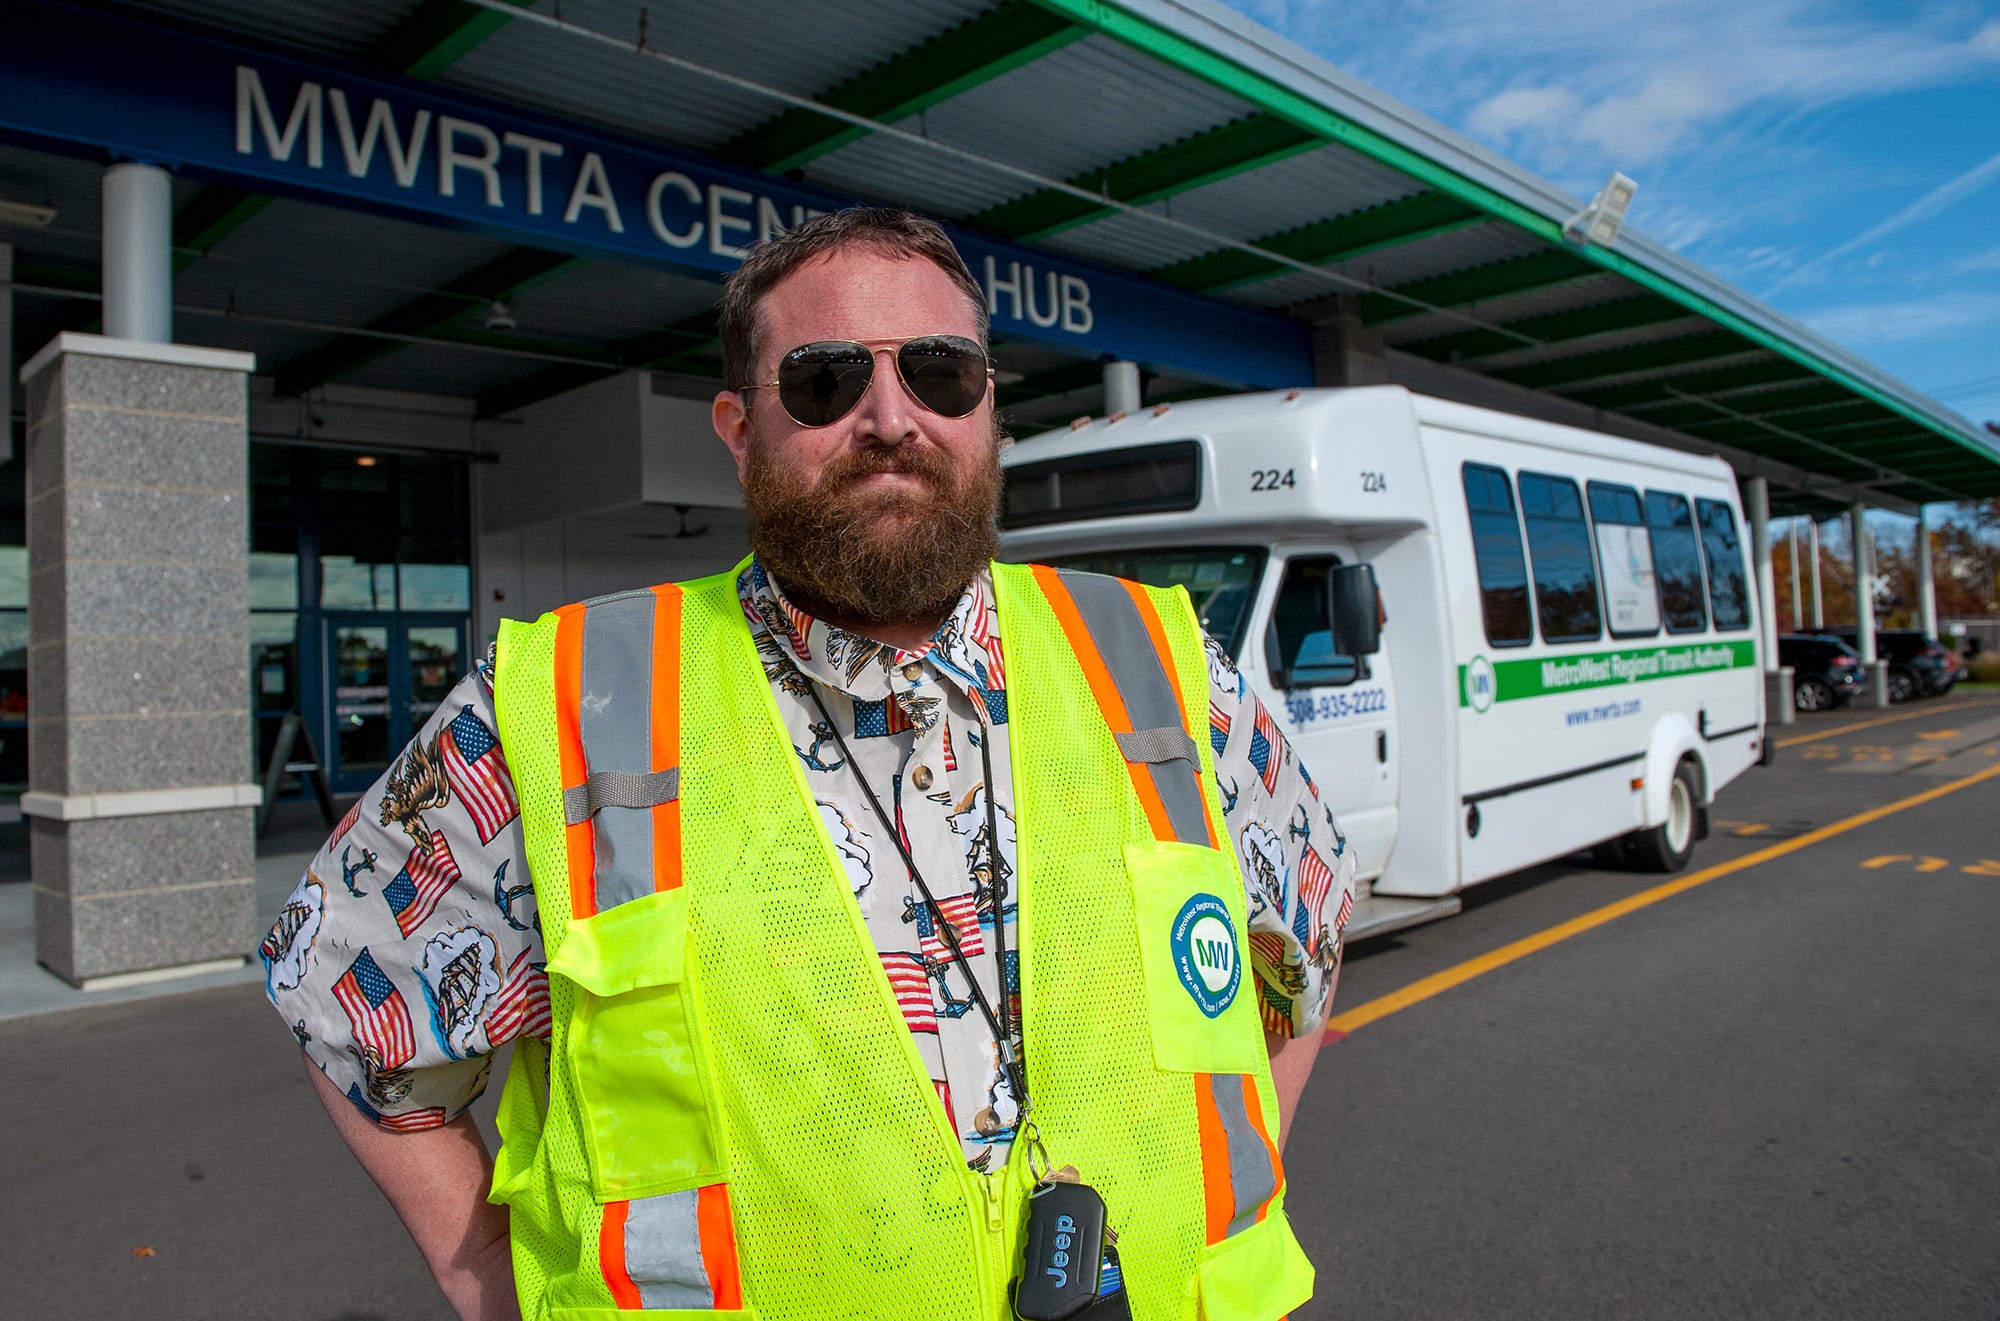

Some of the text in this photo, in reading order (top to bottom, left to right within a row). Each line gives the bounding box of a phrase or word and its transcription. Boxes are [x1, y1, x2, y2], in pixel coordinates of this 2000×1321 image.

[235, 65, 1094, 335] MWRTA CEN HUB
[1251, 468, 1297, 492] 224
[1360, 471, 1388, 493] 224
[1542, 647, 1734, 688] MetroWest Regional Transit Authority
[1286, 688, 1388, 725] 508-935-2222
[1566, 699, 1641, 726] www.mwrta.com
[1195, 937, 1229, 972] MW
[1046, 1214, 1078, 1289] Jeep
